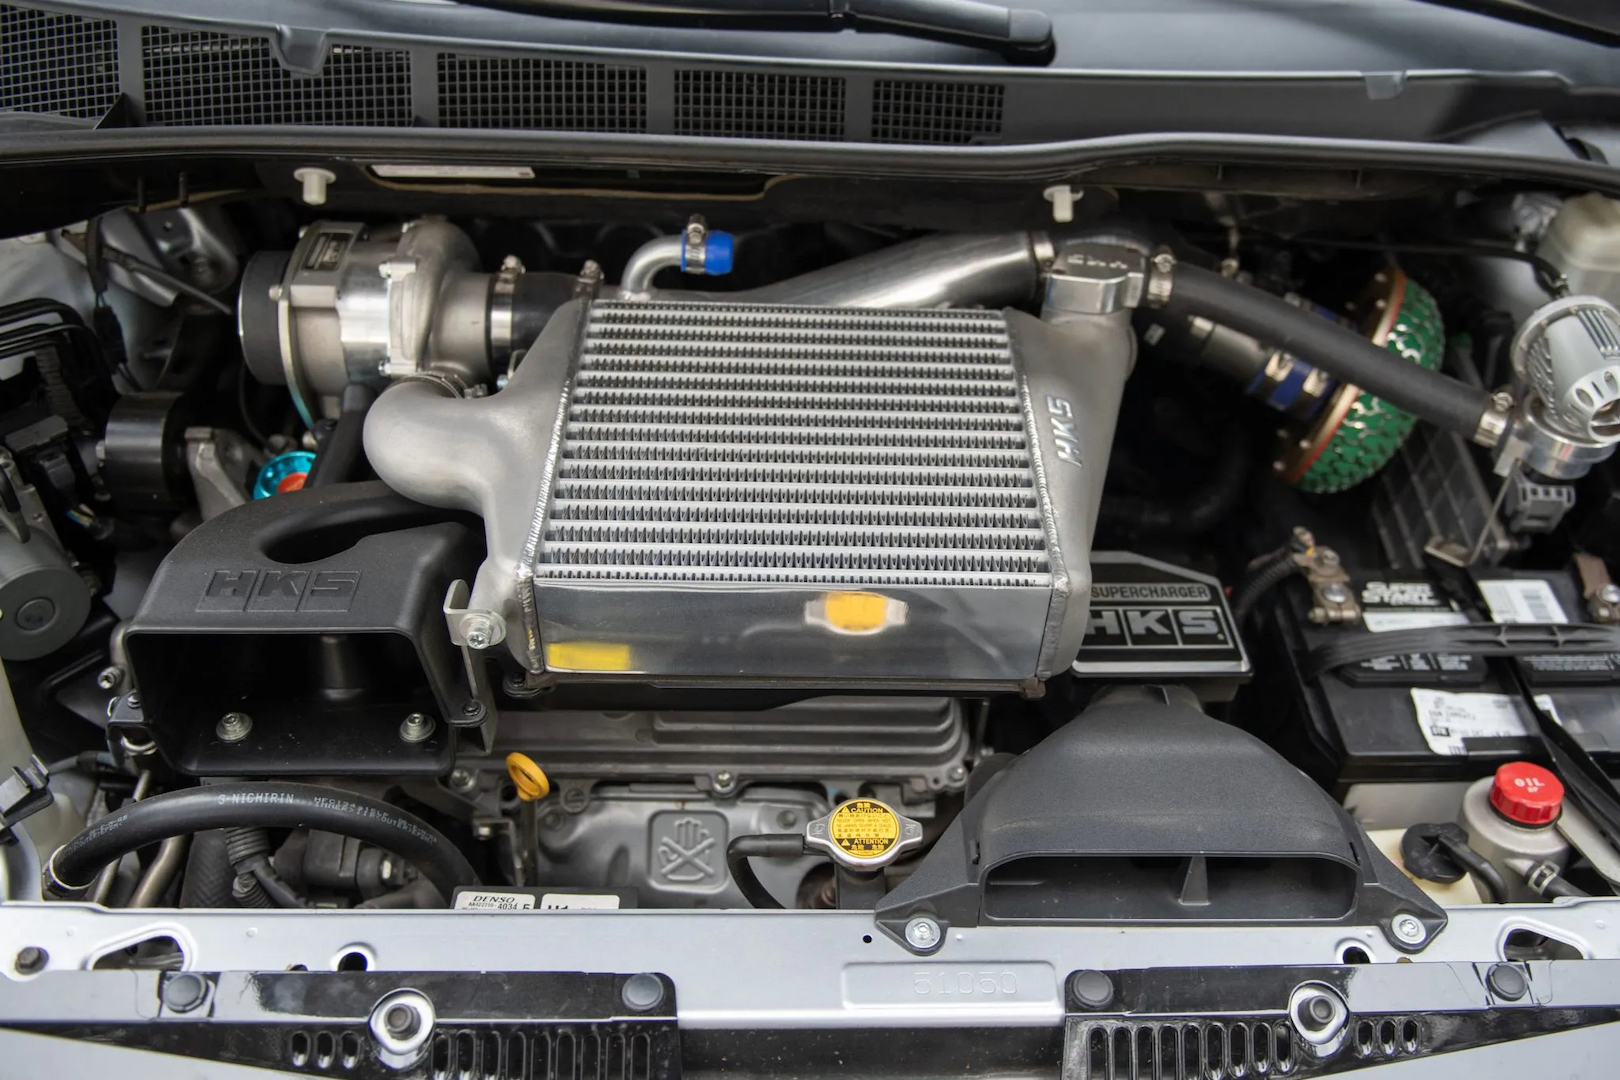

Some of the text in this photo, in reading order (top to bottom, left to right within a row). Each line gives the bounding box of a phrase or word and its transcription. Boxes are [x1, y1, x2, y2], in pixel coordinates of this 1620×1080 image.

[1046, 395, 1082, 468] HKS
[204, 570, 360, 597] HKS
[1091, 586, 1209, 599] SUPERCHARGER
[1085, 610, 1220, 636] HKS
[1514, 777, 1546, 788] OIL
[473, 895, 516, 903] DENSO
[913, 971, 1018, 994] 51050
